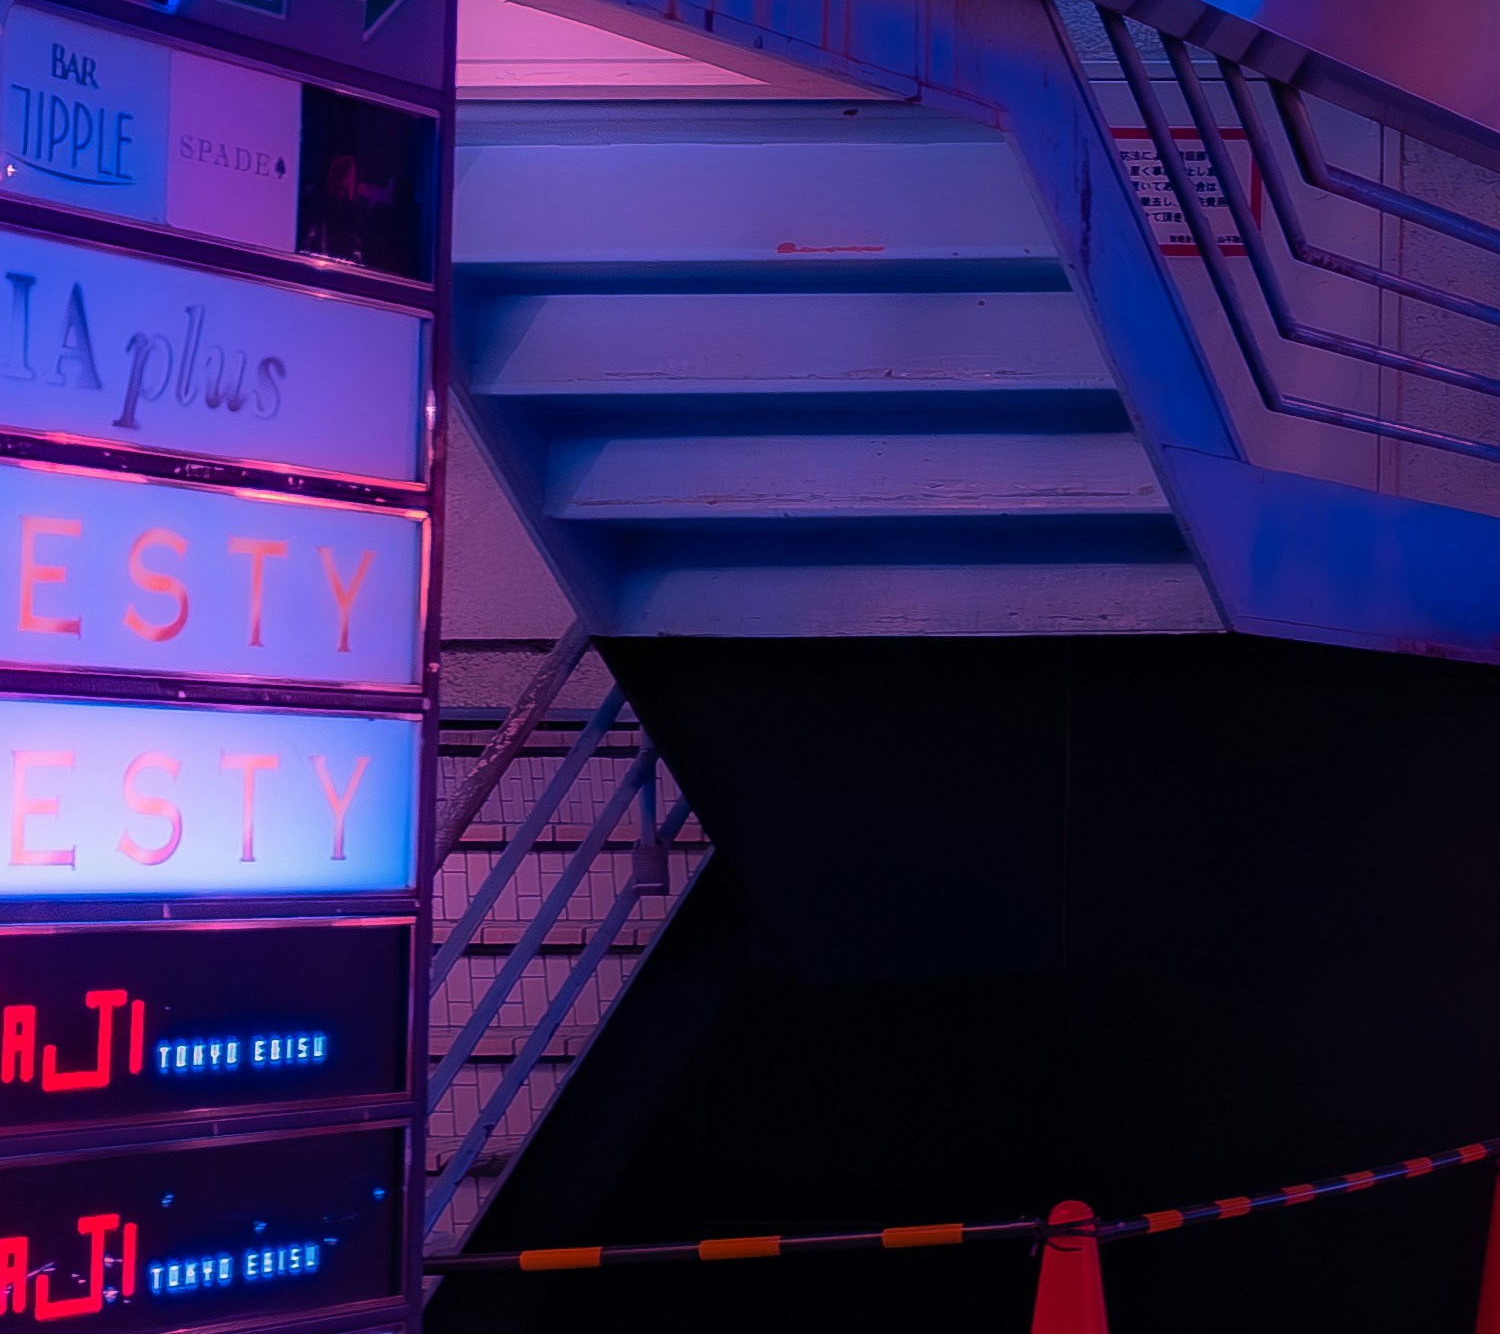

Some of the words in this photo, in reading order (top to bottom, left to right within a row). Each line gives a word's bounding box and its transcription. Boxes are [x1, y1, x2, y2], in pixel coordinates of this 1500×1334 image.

[51, 42, 99, 89] BAR
[10, 83, 135, 182] TIPPLE
[179, 133, 272, 179] SPADE
[112, 302, 288, 430] plus
[17, 514, 379, 654] ESTY
[9, 747, 371, 870] ESTY
[158, 1038, 239, 1072] TOKYO
[254, 1031, 326, 1064] EBISU
[148, 1256, 233, 1295] TOKYO
[246, 1241, 318, 1279] EBISU
